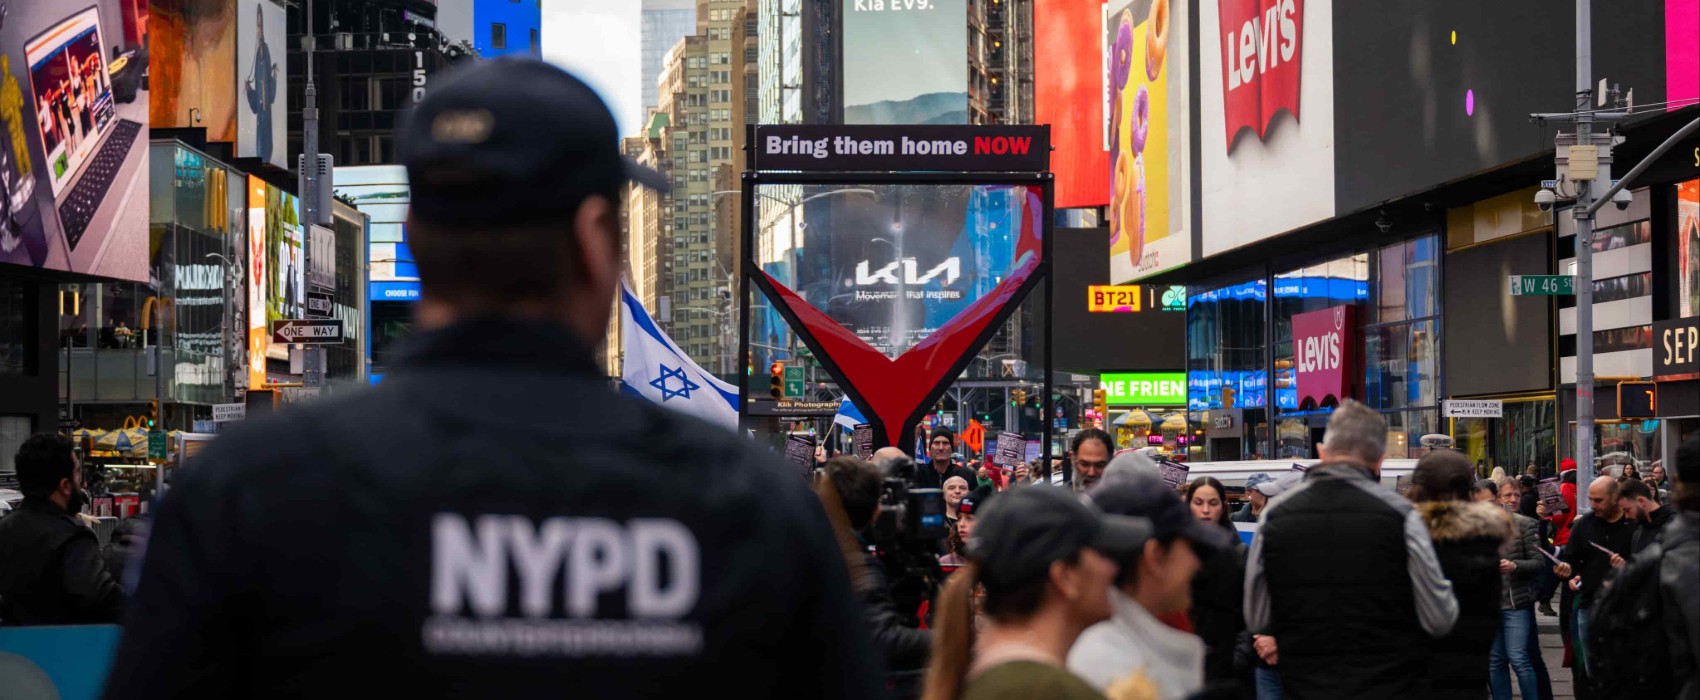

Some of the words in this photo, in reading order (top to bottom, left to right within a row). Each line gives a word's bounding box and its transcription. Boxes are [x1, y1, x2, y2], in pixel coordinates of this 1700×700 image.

[766, 135, 828, 158] Bring
[834, 135, 894, 155] them
[901, 136, 968, 155] home
[974, 136, 1031, 155] NOW
[1524, 279, 1535, 292] W
[1542, 279, 1558, 292] 46
[1563, 279, 1572, 287] St
[1095, 291, 1135, 305] BT21
[284, 327, 303, 336] ONE
[313, 326, 334, 336] WAY
[1129, 380, 1184, 397] FRIEN
[215, 405, 240, 413] PEDESTRIAN
[431, 512, 700, 619] NYPD
